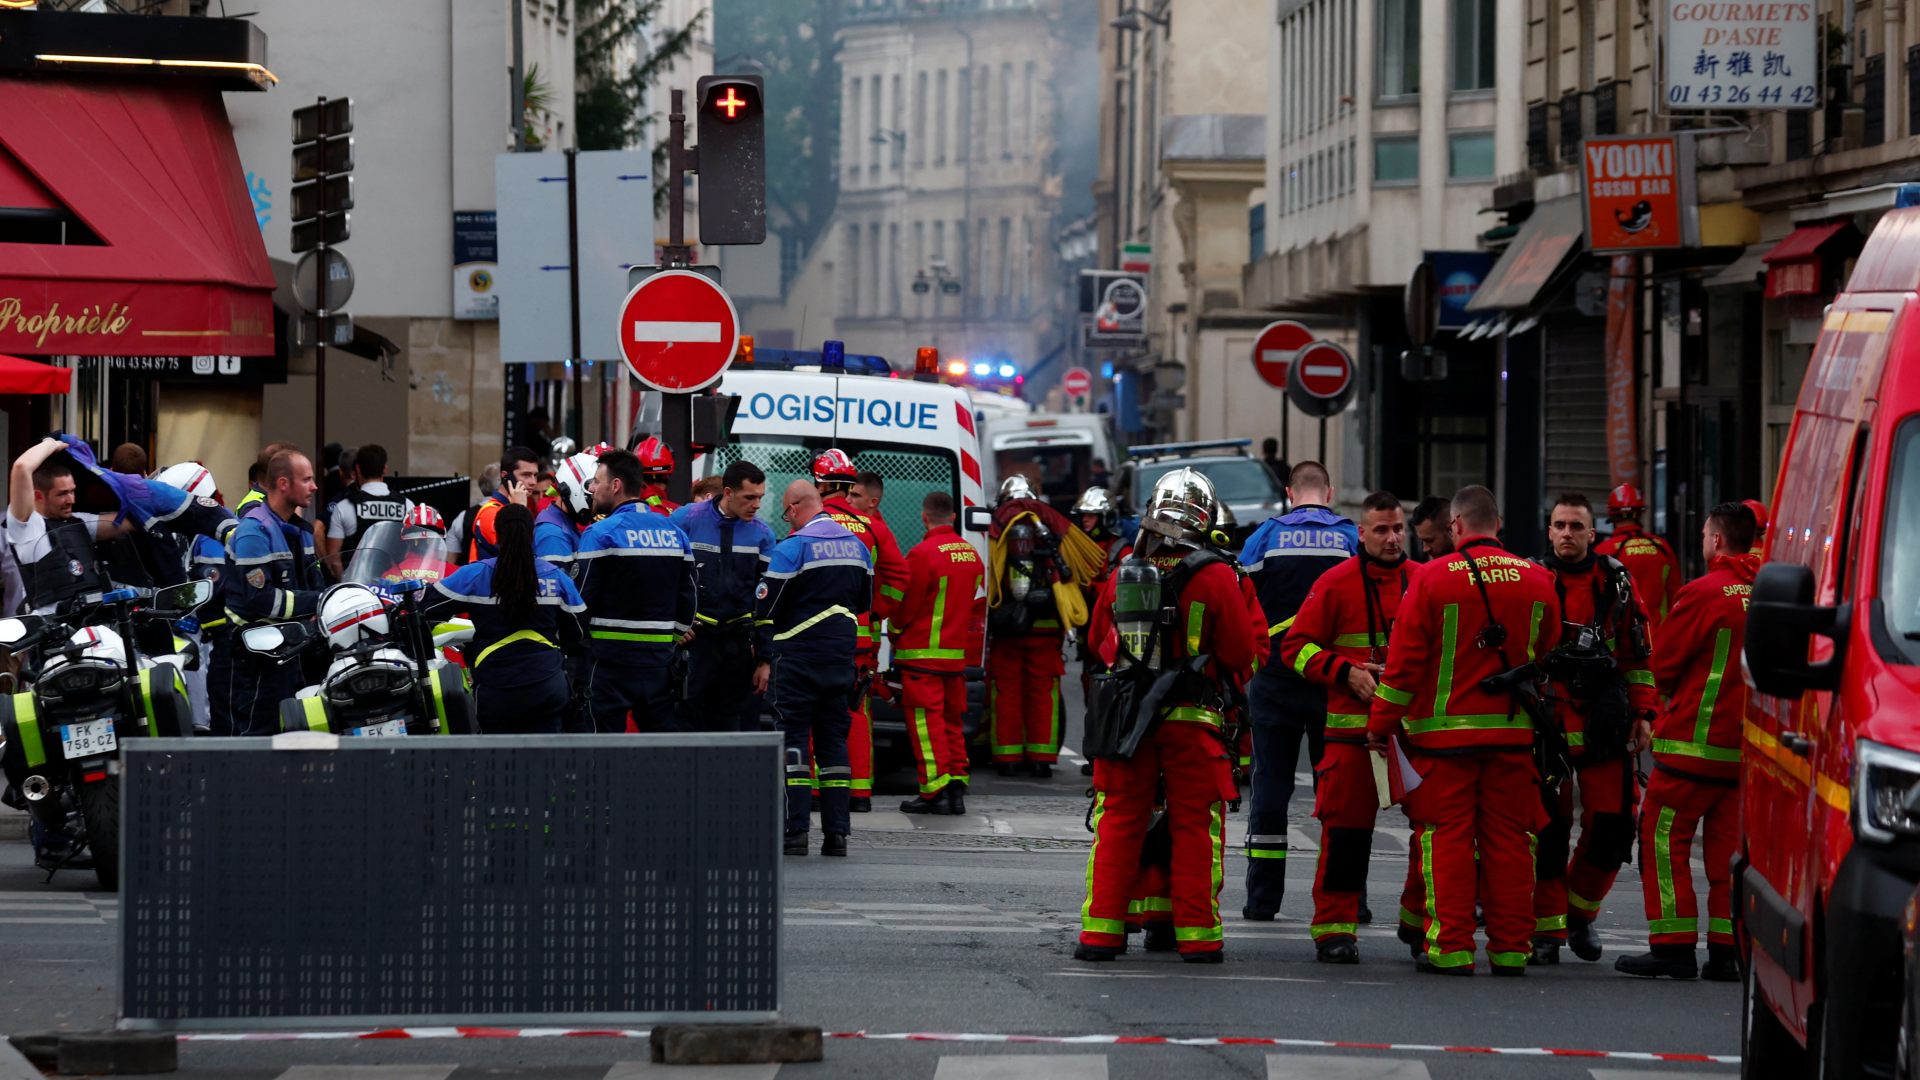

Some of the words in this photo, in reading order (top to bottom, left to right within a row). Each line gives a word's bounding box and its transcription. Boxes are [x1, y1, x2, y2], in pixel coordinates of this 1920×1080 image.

[1672, 3, 1811, 22] GOURMETS
[1702, 27, 1782, 46] D'ASIE
[1693, 49, 1791, 79] 新雅凯
[1670, 85, 1691, 103] 01
[1697, 85, 1722, 103] 43
[1727, 85, 1751, 103] 26
[1757, 85, 1783, 103] 44
[1790, 85, 1815, 103] 42
[1587, 143, 1673, 179] YOOKI
[1593, 181, 1637, 197] SUSHI
[1641, 179, 1671, 195] BAR
[128, 357, 139, 369] 43
[141, 357, 153, 370] 54
[154, 357, 166, 370] 87
[168, 357, 180, 370] 75
[361, 503, 402, 518] POLICE
[841, 522, 866, 533] ARIS
[626, 529, 680, 547] POLICE
[1279, 530, 1345, 548] POLICE
[811, 540, 862, 559] POLICE
[950, 552, 976, 563] PARIS
[1626, 546, 1658, 557] PARIS
[1447, 556, 1489, 572] SAPERS
[1489, 555, 1531, 569] POMPIERS
[1467, 568, 1521, 586] PARIS
[1723, 584, 1753, 597] SAPEUR
[76, 725, 92, 737] FK
[66, 733, 113, 751] 758-CZ
